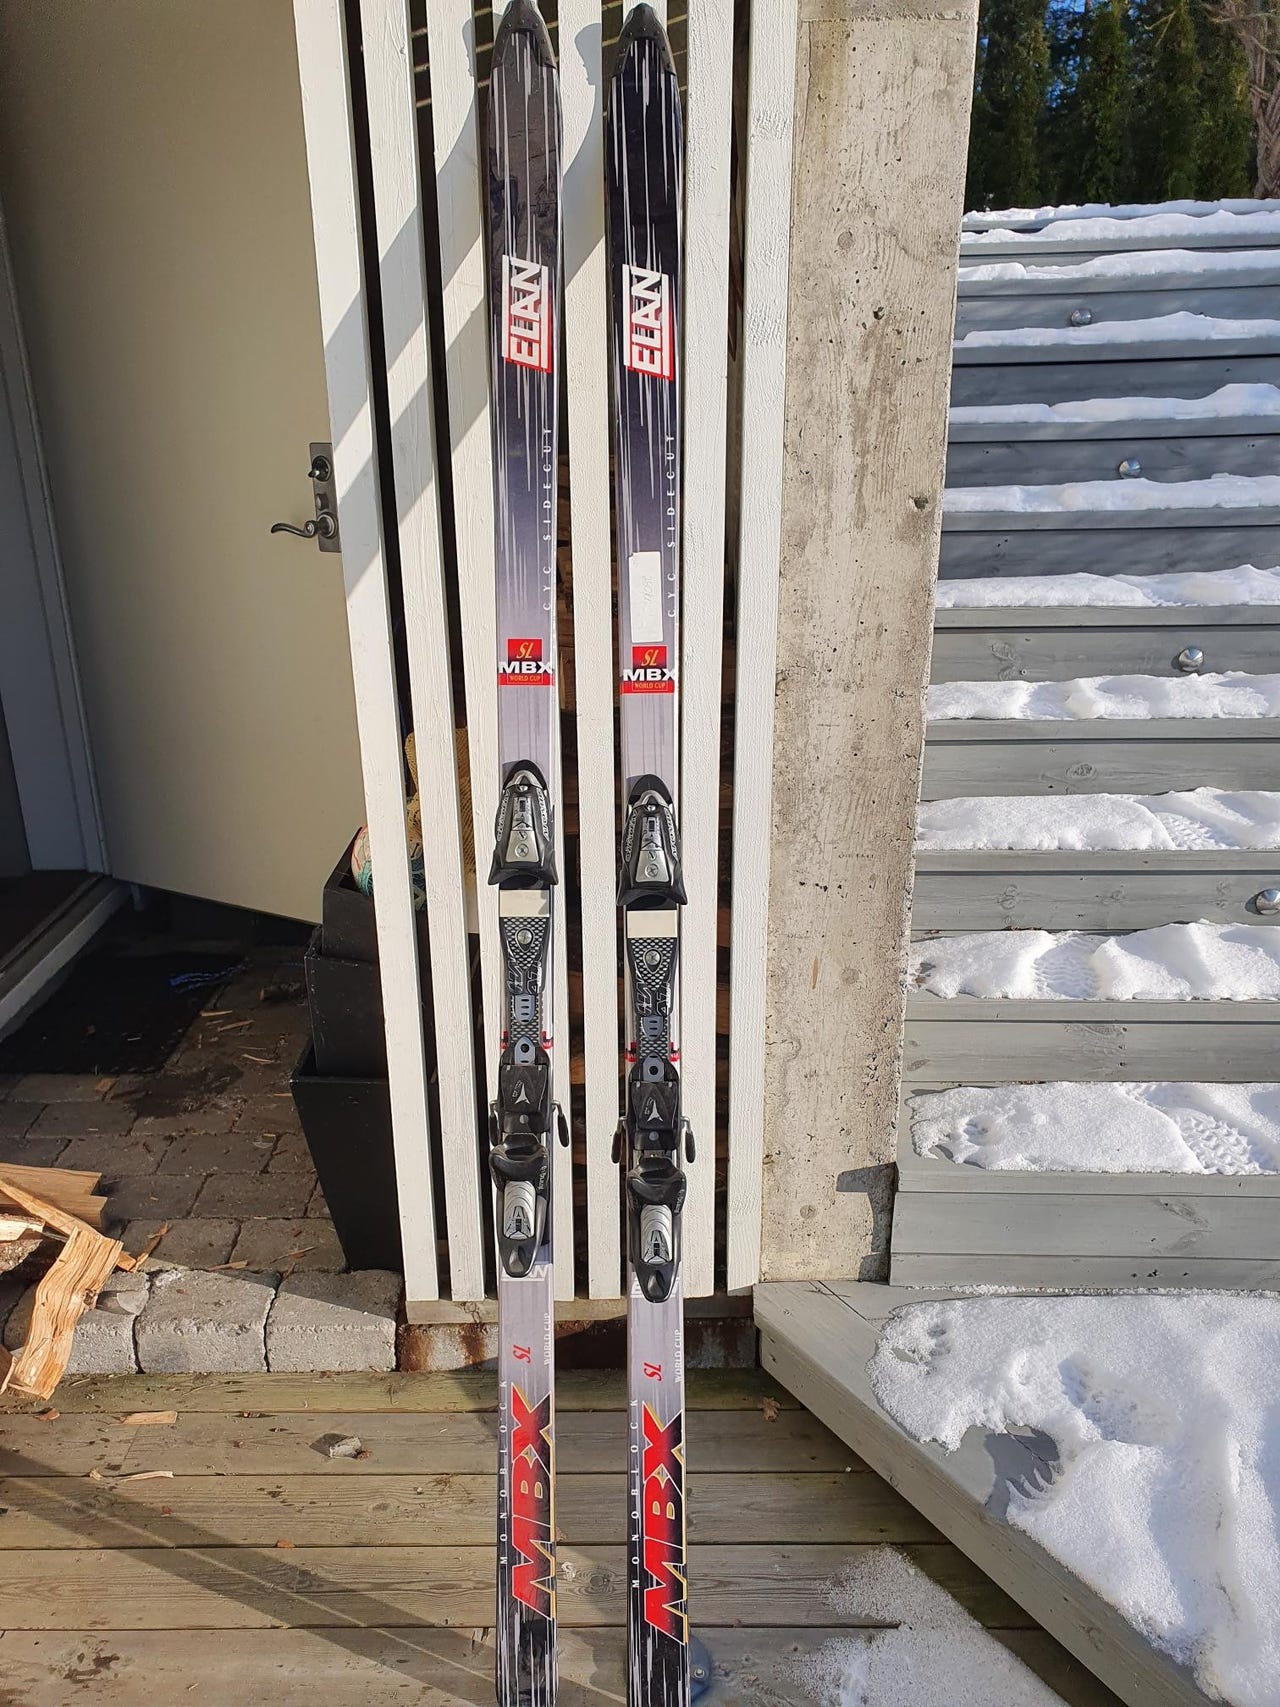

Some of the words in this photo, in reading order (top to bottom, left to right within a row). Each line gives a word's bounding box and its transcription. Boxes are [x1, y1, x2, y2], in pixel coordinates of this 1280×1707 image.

[509, 256, 542, 366] ELAN
[631, 266, 663, 375] ELAN
[543, 428, 551, 541] SIDECUT
[666, 434, 676, 549] SIDECUT
[543, 566, 551, 611] CYC
[667, 573, 676, 618] CYC
[516, 642, 533, 659] SL
[641, 649, 658, 667] SL
[498, 661, 552, 674] MBX
[509, 674, 528, 682] WORLD
[529, 674, 541, 682] CUP
[623, 669, 675, 682] MBX
[543, 1311, 551, 1331] CUP
[513, 1344, 531, 1363] SL
[543, 1334, 551, 1366] WORLD
[674, 1329, 682, 1348] CUP
[643, 1362, 662, 1382] SL
[674, 1351, 682, 1383] WORLD
[500, 1381, 508, 1564] MONOBLOCK
[511, 1382, 555, 1620] MBX
[630, 1400, 639, 1588] MONOBLOCK
[643, 1401, 687, 1645] MBX
